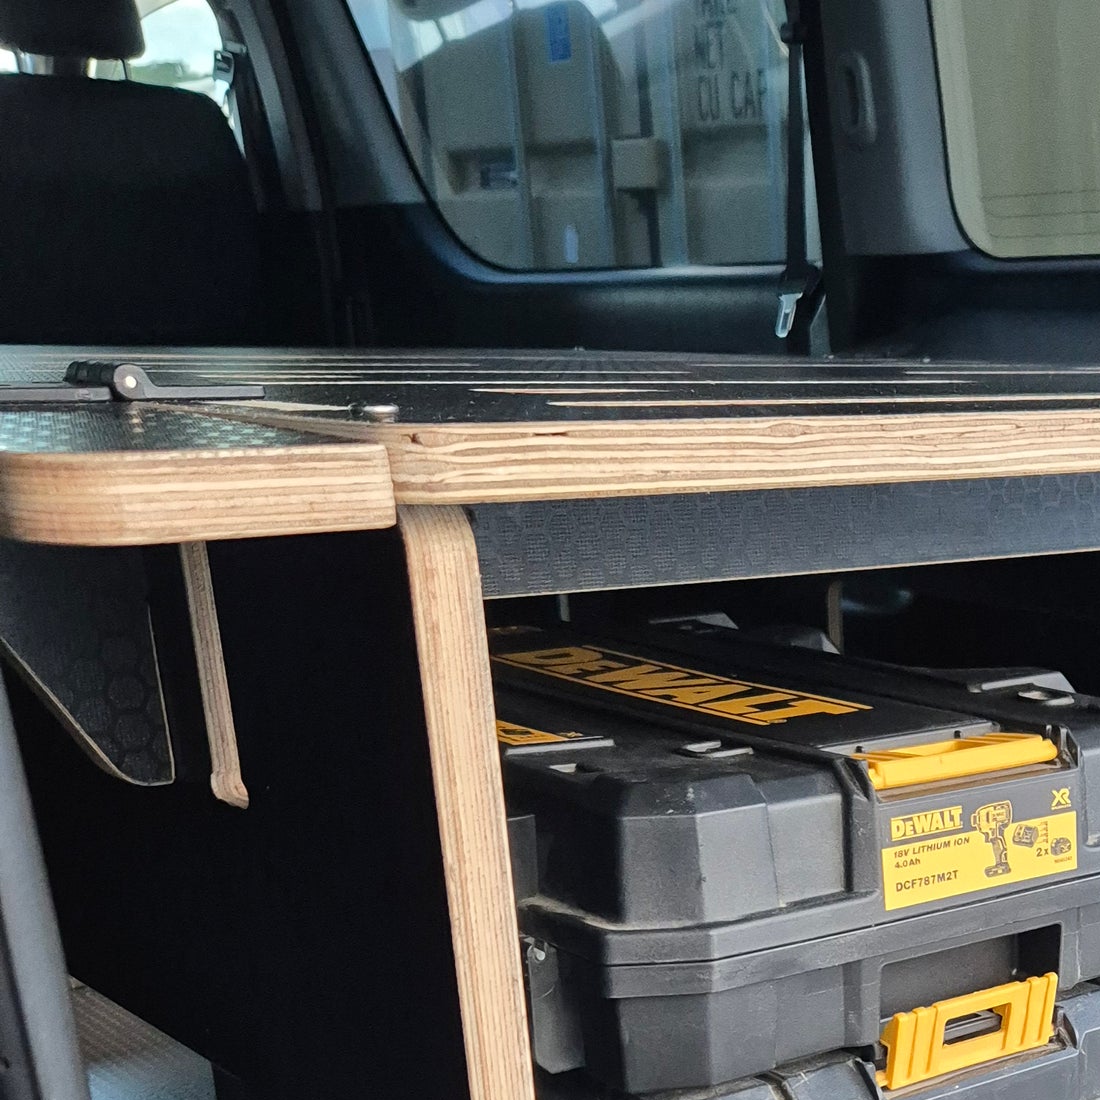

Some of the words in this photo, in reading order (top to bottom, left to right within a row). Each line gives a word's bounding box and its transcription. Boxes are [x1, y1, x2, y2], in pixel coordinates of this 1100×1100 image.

[894, 849, 910, 859] 18V
[912, 840, 951, 854] LITHIUM
[954, 836, 970, 846] ION
[896, 869, 959, 892] DCF787M2T
